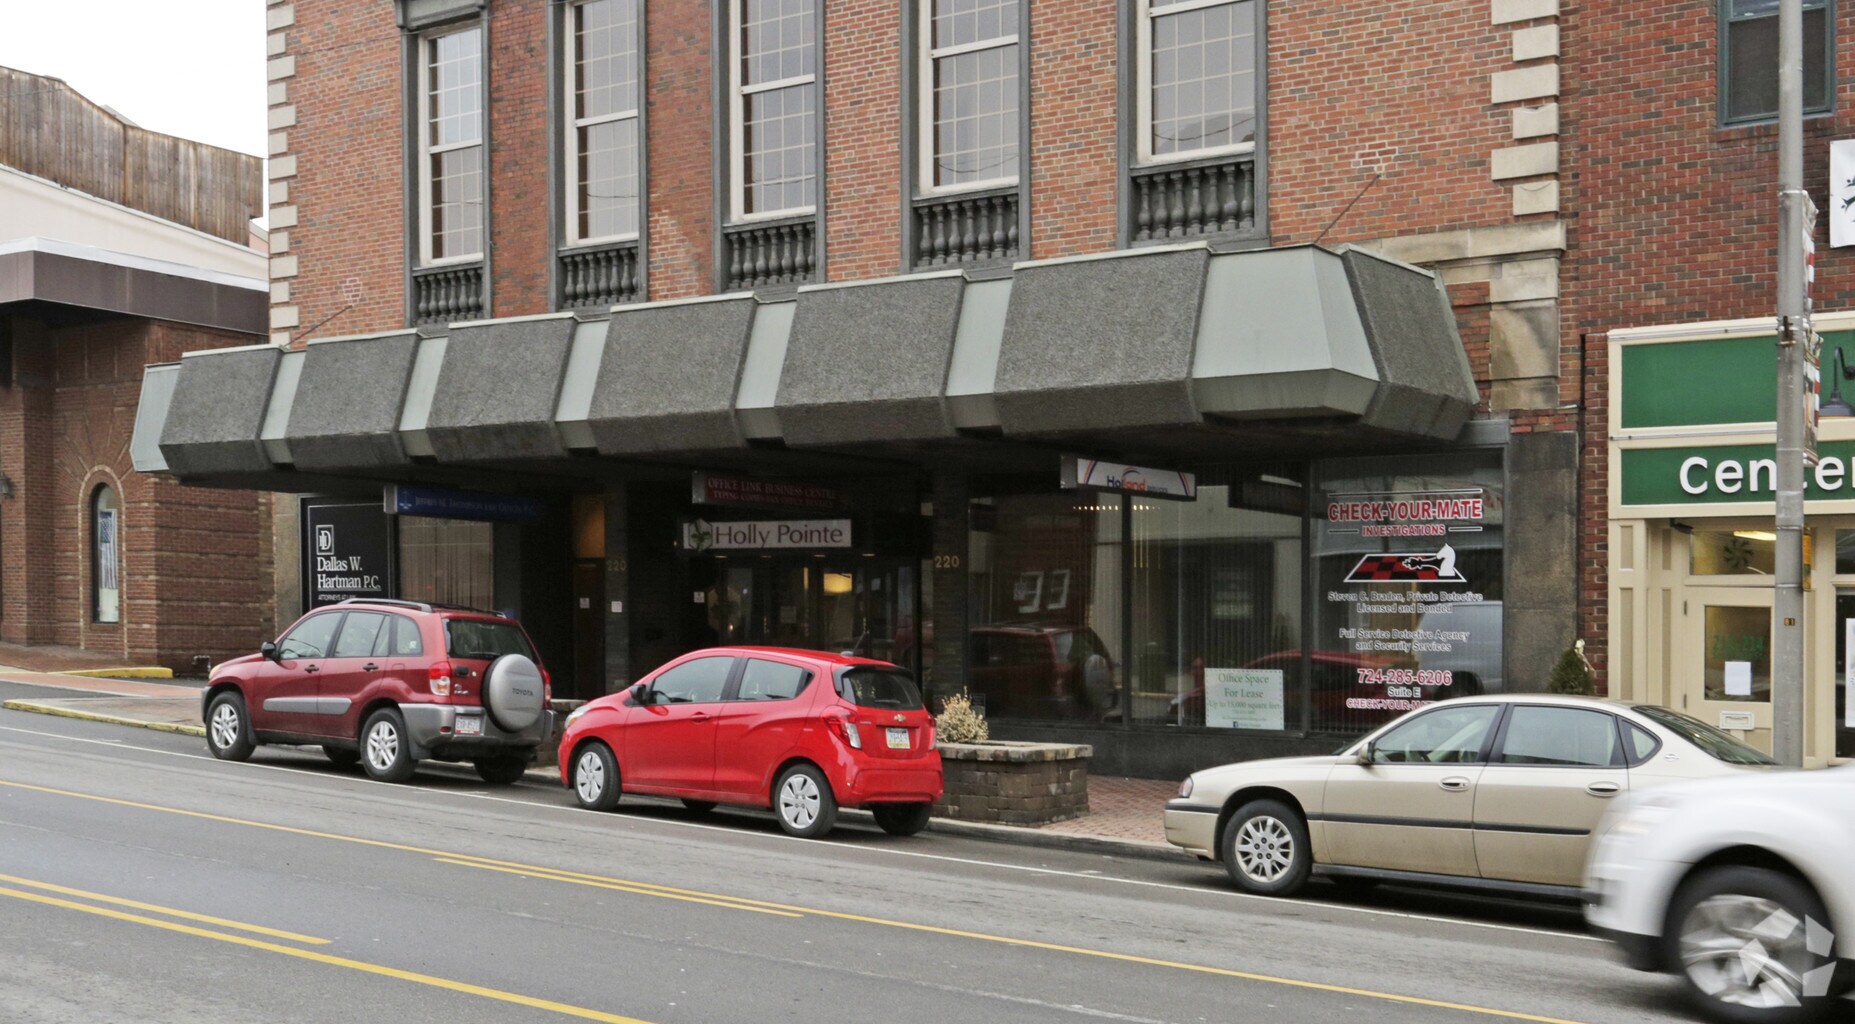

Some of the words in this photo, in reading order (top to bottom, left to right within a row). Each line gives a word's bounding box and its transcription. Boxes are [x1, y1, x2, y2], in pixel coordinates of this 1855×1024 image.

[1680, 456, 1855, 494] Cene
[708, 478, 738, 490] OFFICE
[741, 481, 762, 492] LINK
[765, 483, 803, 495] BUSINESS
[1328, 499, 1483, 522] CHECK-YOUR-MATE
[715, 524, 770, 548] Holly
[777, 524, 843, 544] Pointe
[1362, 524, 1446, 536] INVESTIGATIONS
[317, 557, 348, 572] Dallas
[349, 557, 363, 571] W.
[607, 560, 627, 571] 220
[934, 555, 960, 568] 220
[317, 574, 361, 588] Hartman
[1328, 591, 1358, 601] Steven
[1371, 591, 1405, 602] Braden,
[1407, 591, 1438, 601] Private
[1440, 591, 1483, 601] Detective
[1357, 604, 1397, 613] Licensed
[1398, 604, 1415, 613] and
[1417, 603, 1452, 613] Bonded
[1339, 628, 1356, 639] Full
[1357, 629, 1390, 639] Service
[1392, 629, 1433, 639] Detective
[1434, 629, 1470, 643] Agency
[1356, 641, 1373, 651] and
[1375, 641, 1411, 653] Security
[1412, 641, 1452, 652] Services
[1218, 673, 1243, 683] Office
[1245, 674, 1269, 686] Space
[1357, 668, 1452, 686] 724-285-6206
[512, 688, 533, 696] TOYOTA
[1224, 688, 1239, 697] For
[1241, 688, 1264, 698] Lease
[1388, 686, 1412, 698] Suite
[1413, 687, 1421, 697] E
